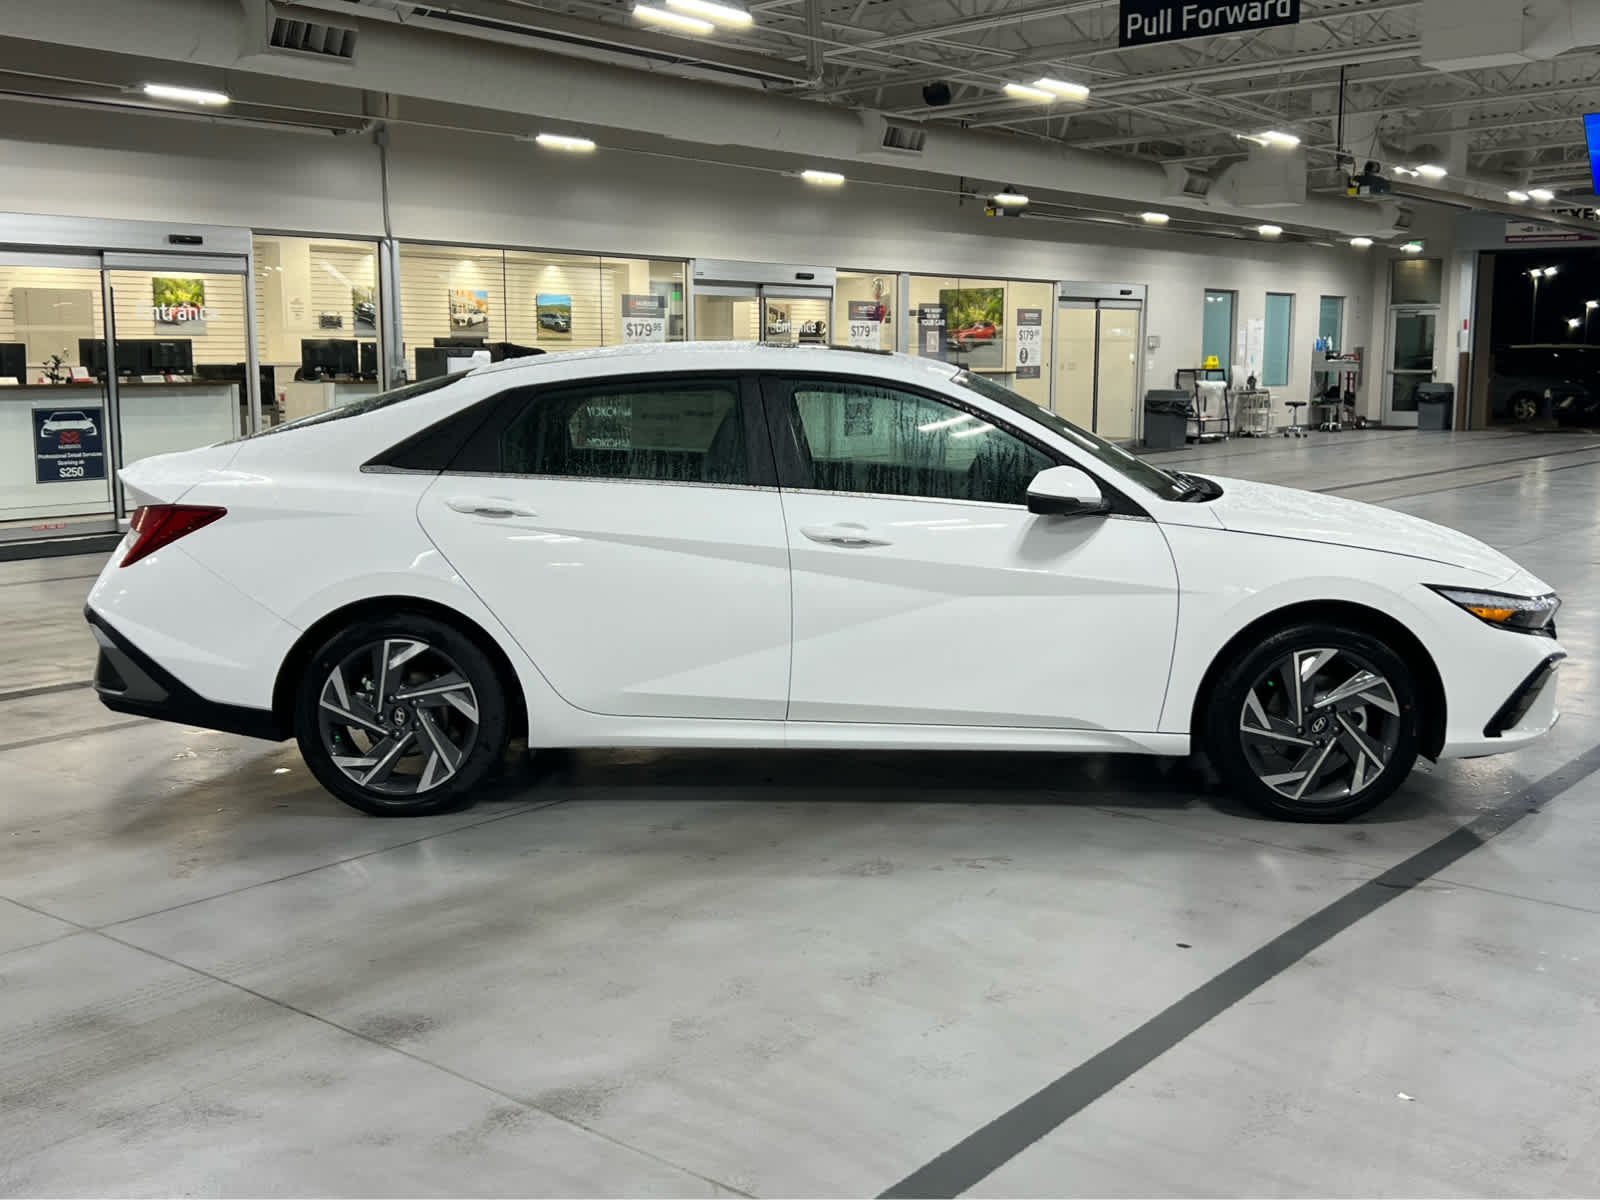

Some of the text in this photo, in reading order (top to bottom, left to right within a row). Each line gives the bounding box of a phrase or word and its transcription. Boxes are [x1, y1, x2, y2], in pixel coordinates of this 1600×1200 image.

[1127, 0, 1292, 39] Pull Forward
[626, 322, 652, 338] $179
[851, 325, 870, 337] $179
[59, 466, 84, 478] $250
